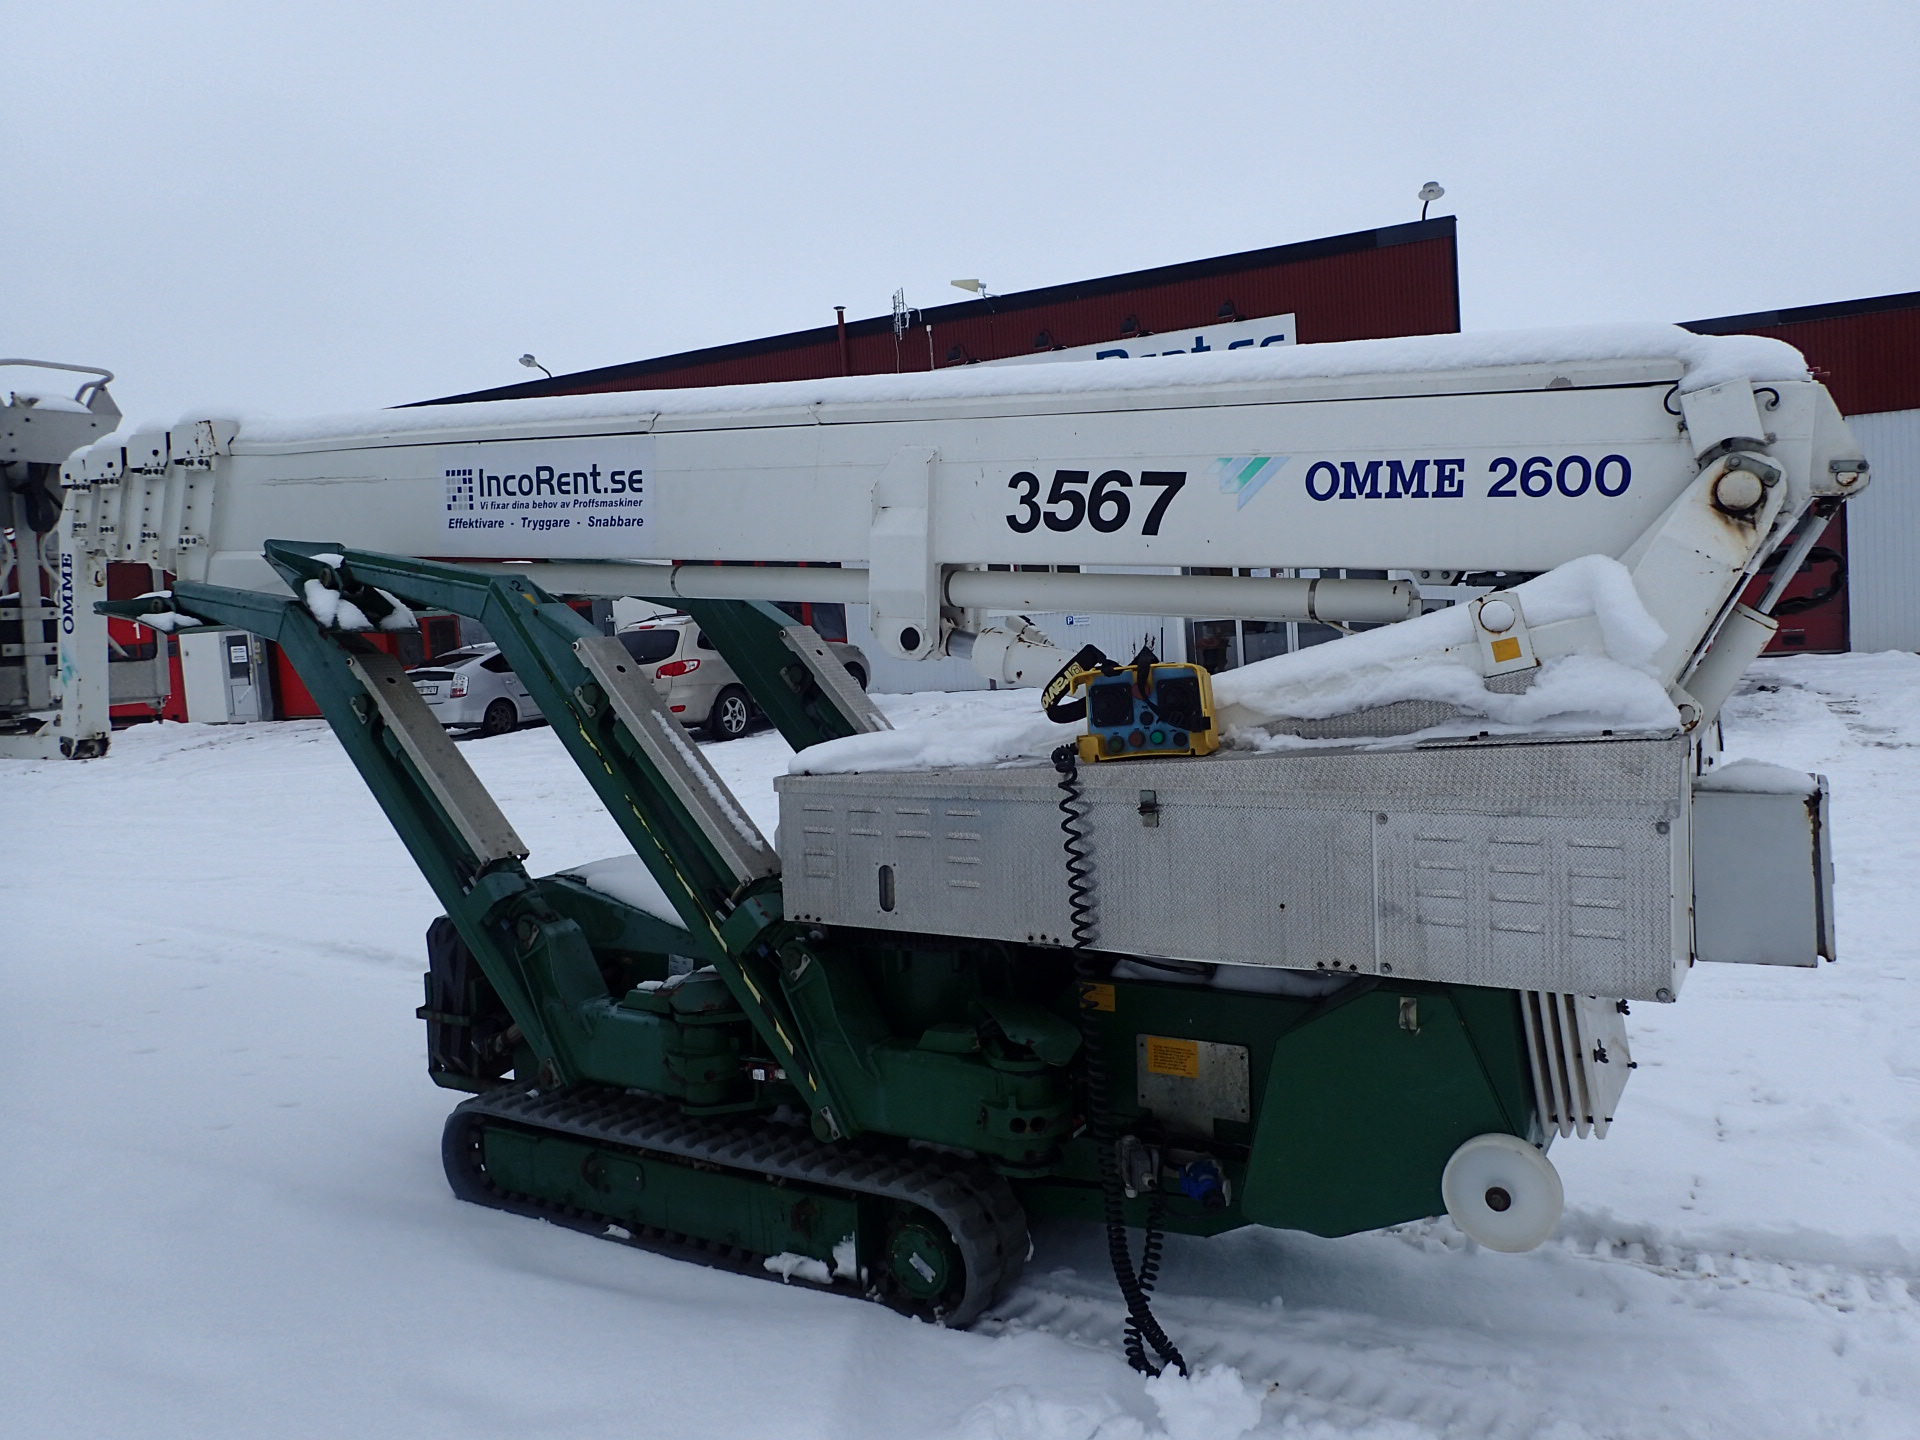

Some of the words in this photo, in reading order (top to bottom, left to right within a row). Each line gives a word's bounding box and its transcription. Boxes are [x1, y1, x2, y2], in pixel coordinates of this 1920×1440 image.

[479, 464, 643, 497] IncoRent.se
[1305, 459, 1465, 501] OMME
[1487, 454, 1632, 498] 2600
[448, 517, 504, 529] Effektivare
[521, 516, 570, 531] Tryggare
[588, 515, 644, 527] Snabbare
[480, 501, 489, 510] Vi
[490, 500, 510, 510] fixar
[511, 500, 530, 510] dina
[532, 499, 558, 509] behov
[560, 500, 570, 509] av
[573, 497, 643, 509] Proffsmaskiner
[1006, 470, 1187, 536] 3567
[62, 553, 74, 634] OMME
